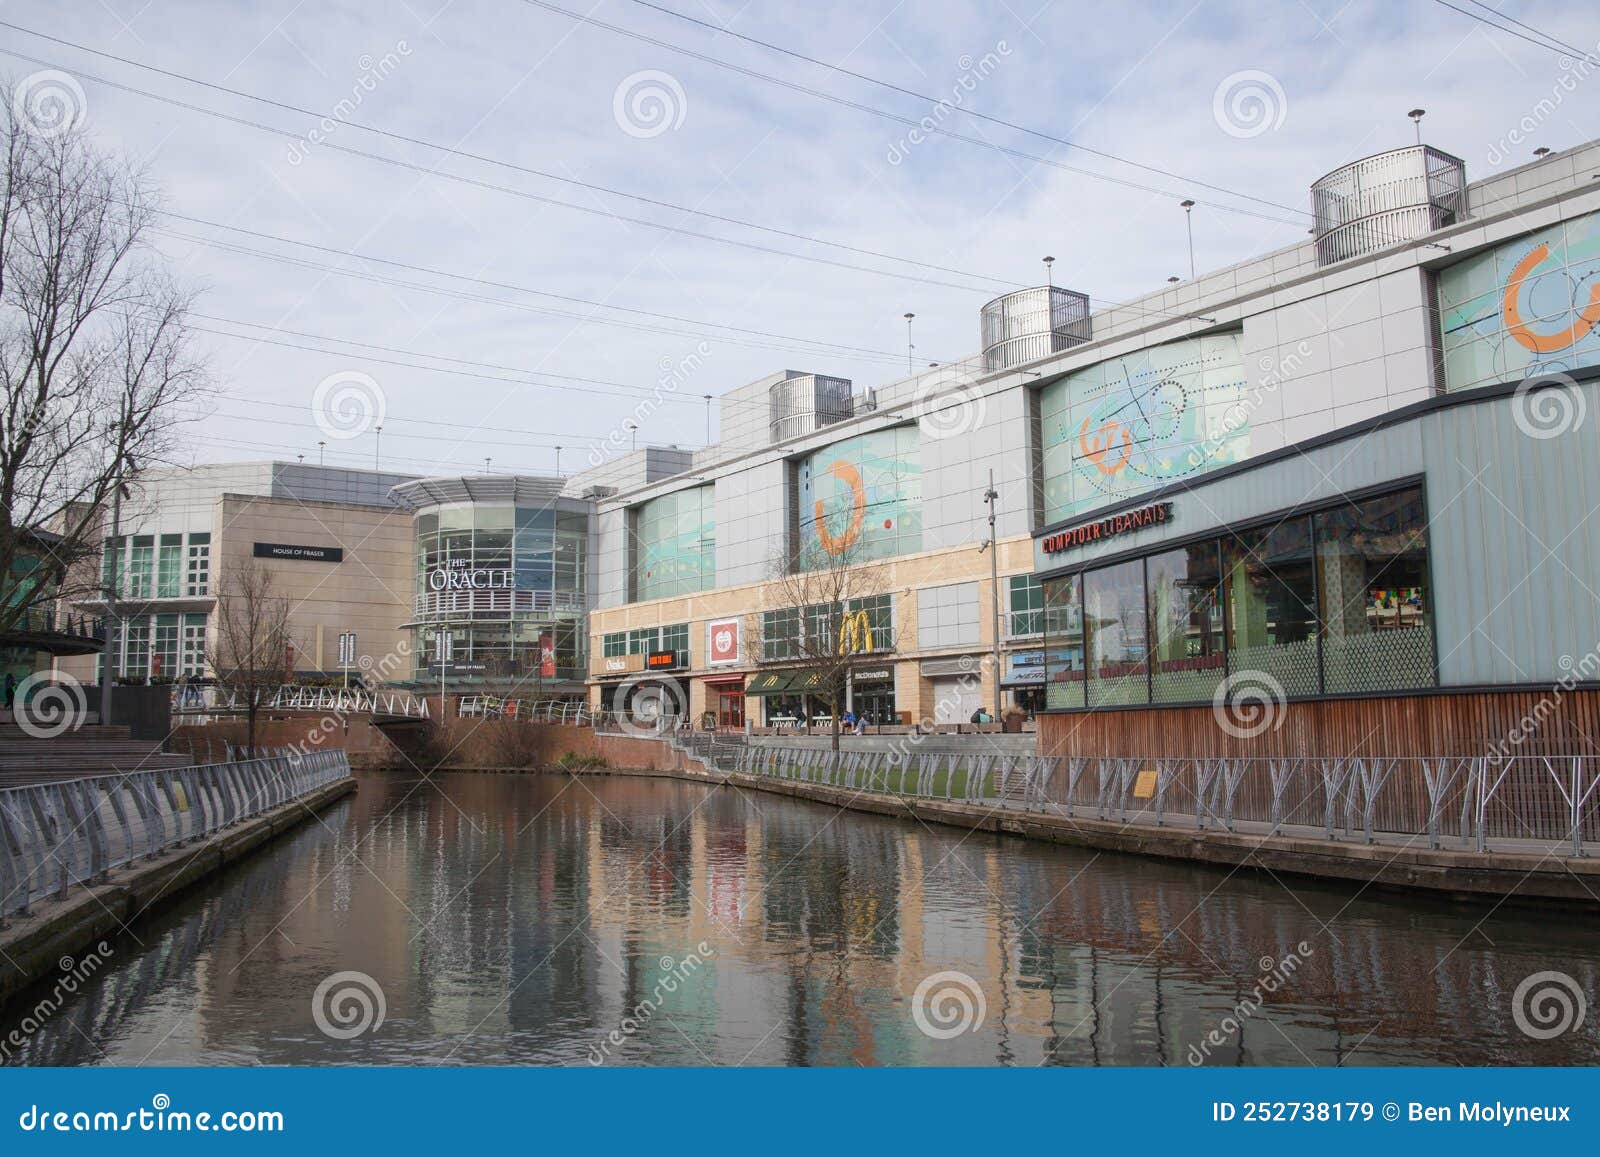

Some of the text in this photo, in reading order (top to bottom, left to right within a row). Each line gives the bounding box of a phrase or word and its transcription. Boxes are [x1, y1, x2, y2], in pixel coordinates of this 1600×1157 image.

[1042, 503, 1168, 554] COMPTOIR LIBANAIS
[273, 547, 293, 555] HOUSE
[446, 558, 466, 567] THE
[430, 568, 517, 591] ORACLE
